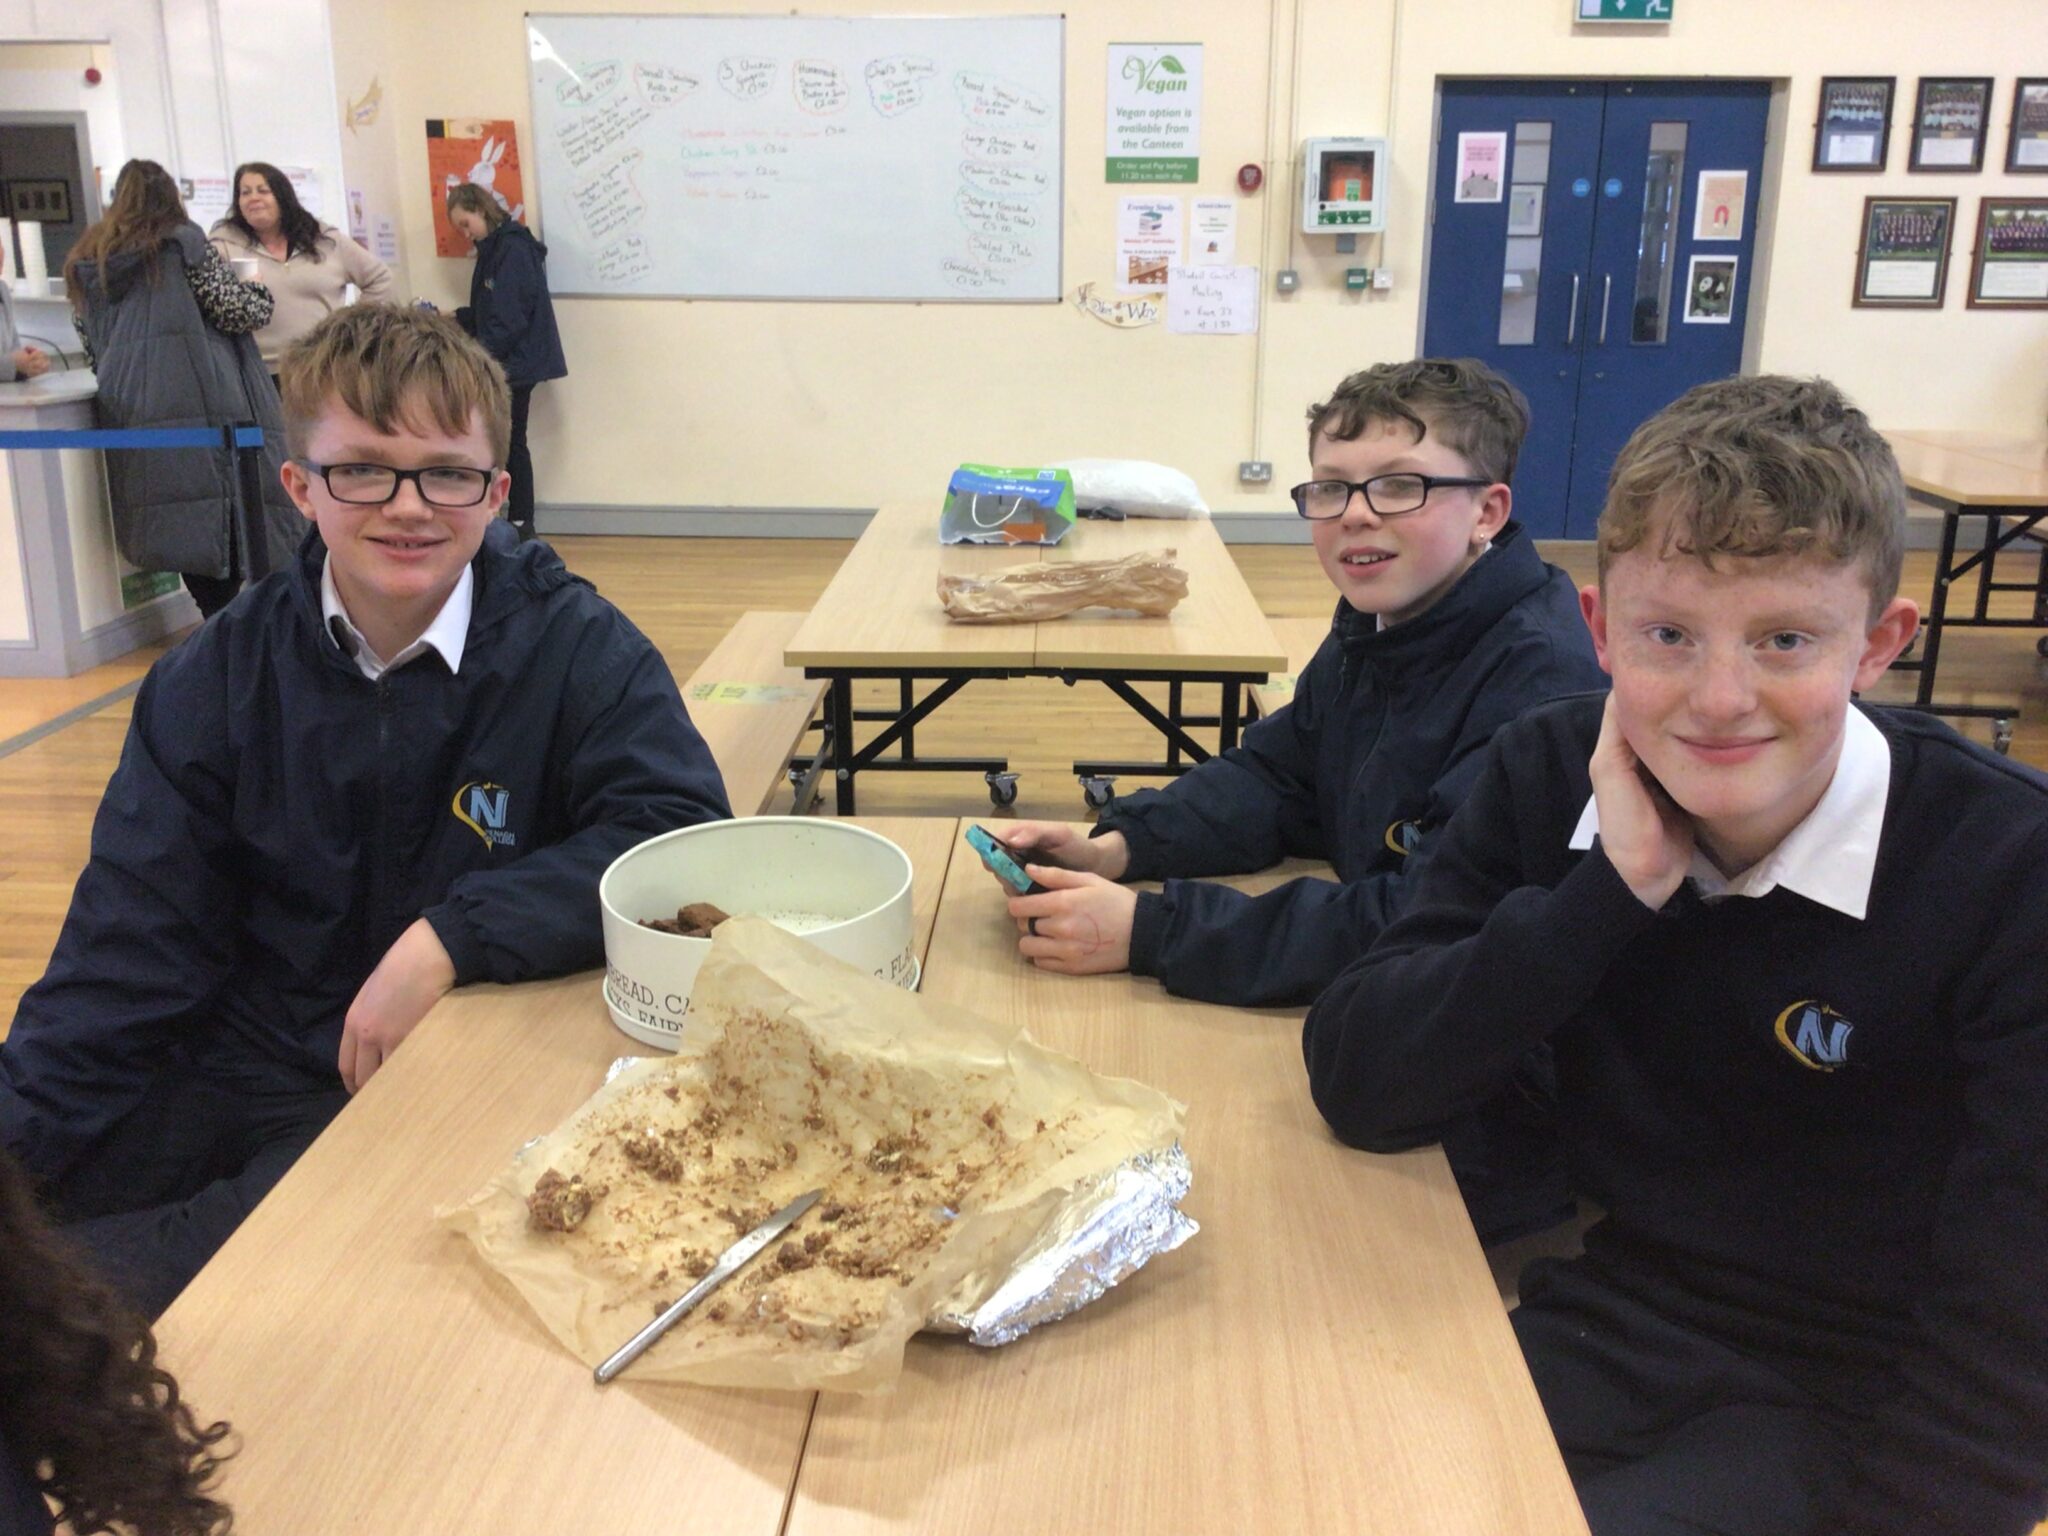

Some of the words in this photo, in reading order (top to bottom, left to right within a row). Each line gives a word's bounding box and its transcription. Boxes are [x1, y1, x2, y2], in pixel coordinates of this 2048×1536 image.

[1122, 55, 1188, 94] Vegan
[1116, 107, 1146, 120] Vegan
[1149, 108, 1182, 119] option
[1185, 108, 1192, 118] is
[1117, 123, 1162, 134] available
[1165, 123, 1190, 135] from
[1122, 139, 1138, 149] the
[1141, 139, 1184, 149] Canteen
